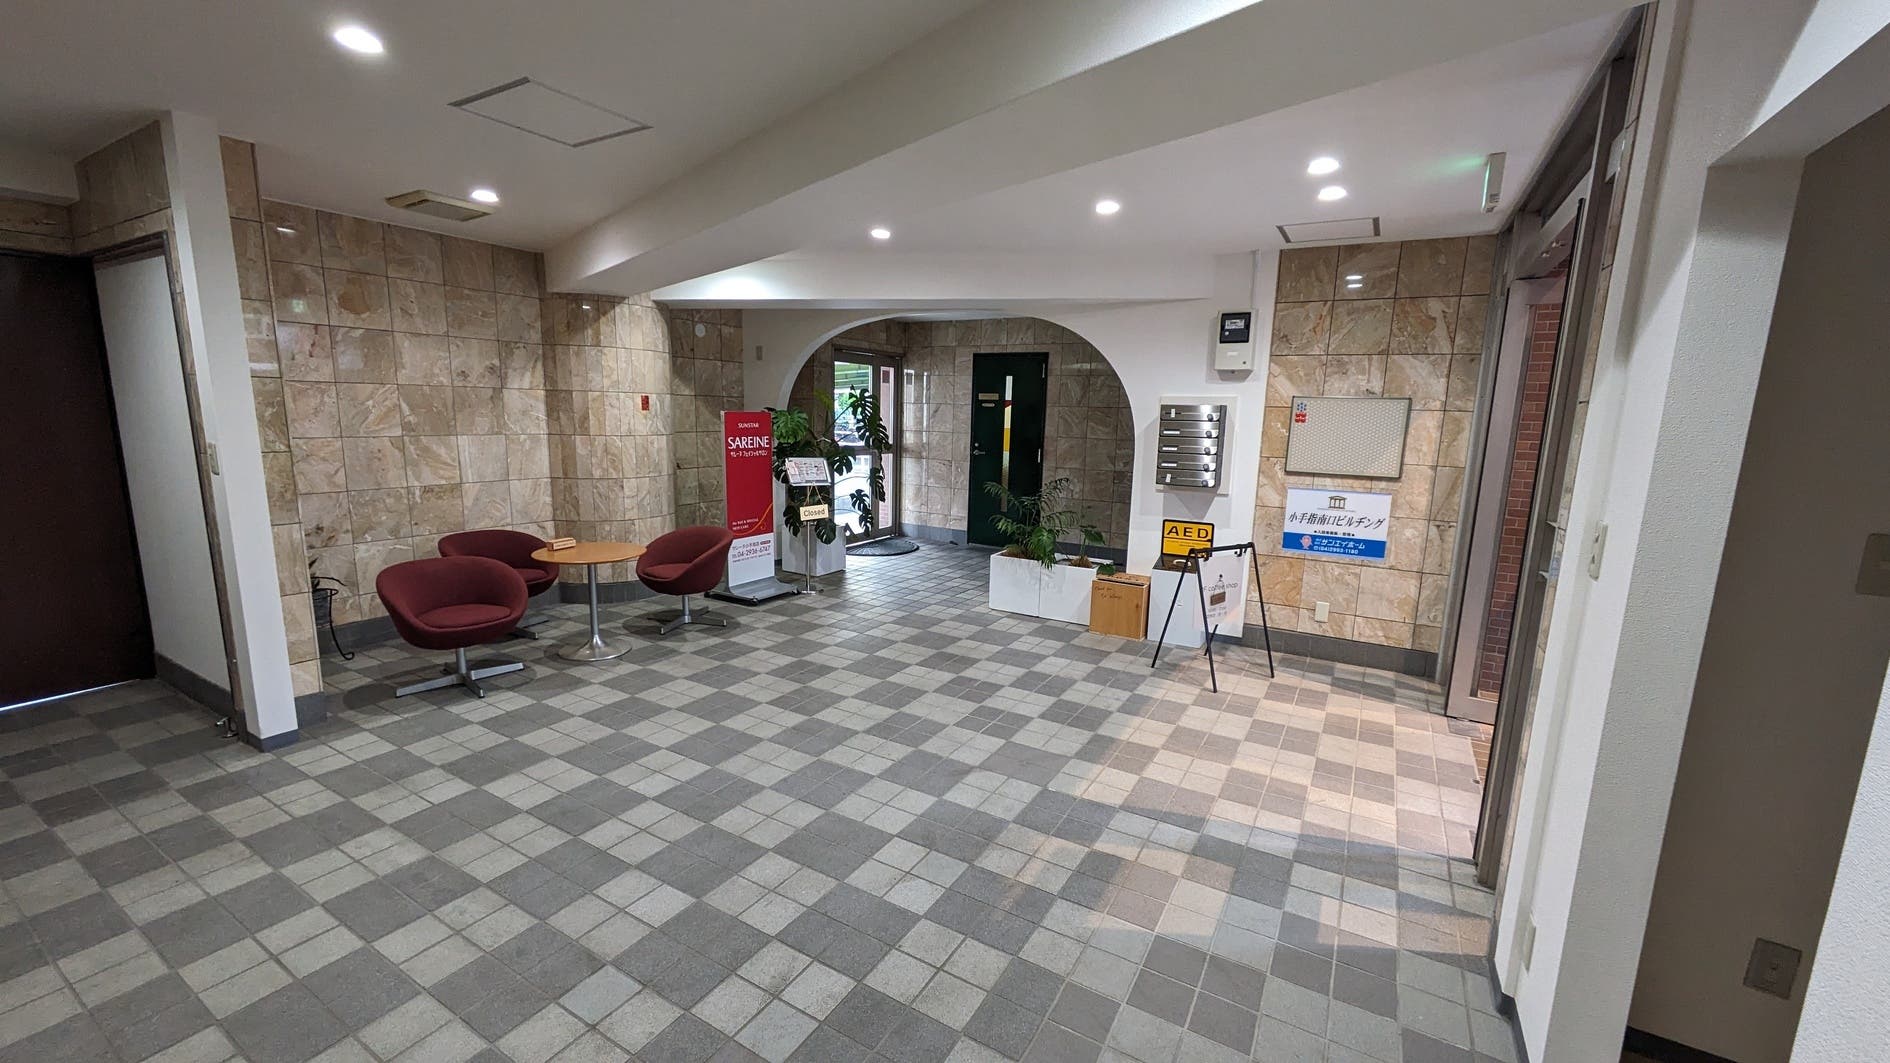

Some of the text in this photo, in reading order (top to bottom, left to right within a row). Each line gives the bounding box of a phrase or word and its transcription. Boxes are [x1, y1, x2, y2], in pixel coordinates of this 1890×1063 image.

[728, 436, 770, 449] SAREINE
[803, 508, 826, 517] Closed
[1167, 525, 1209, 538] AED
